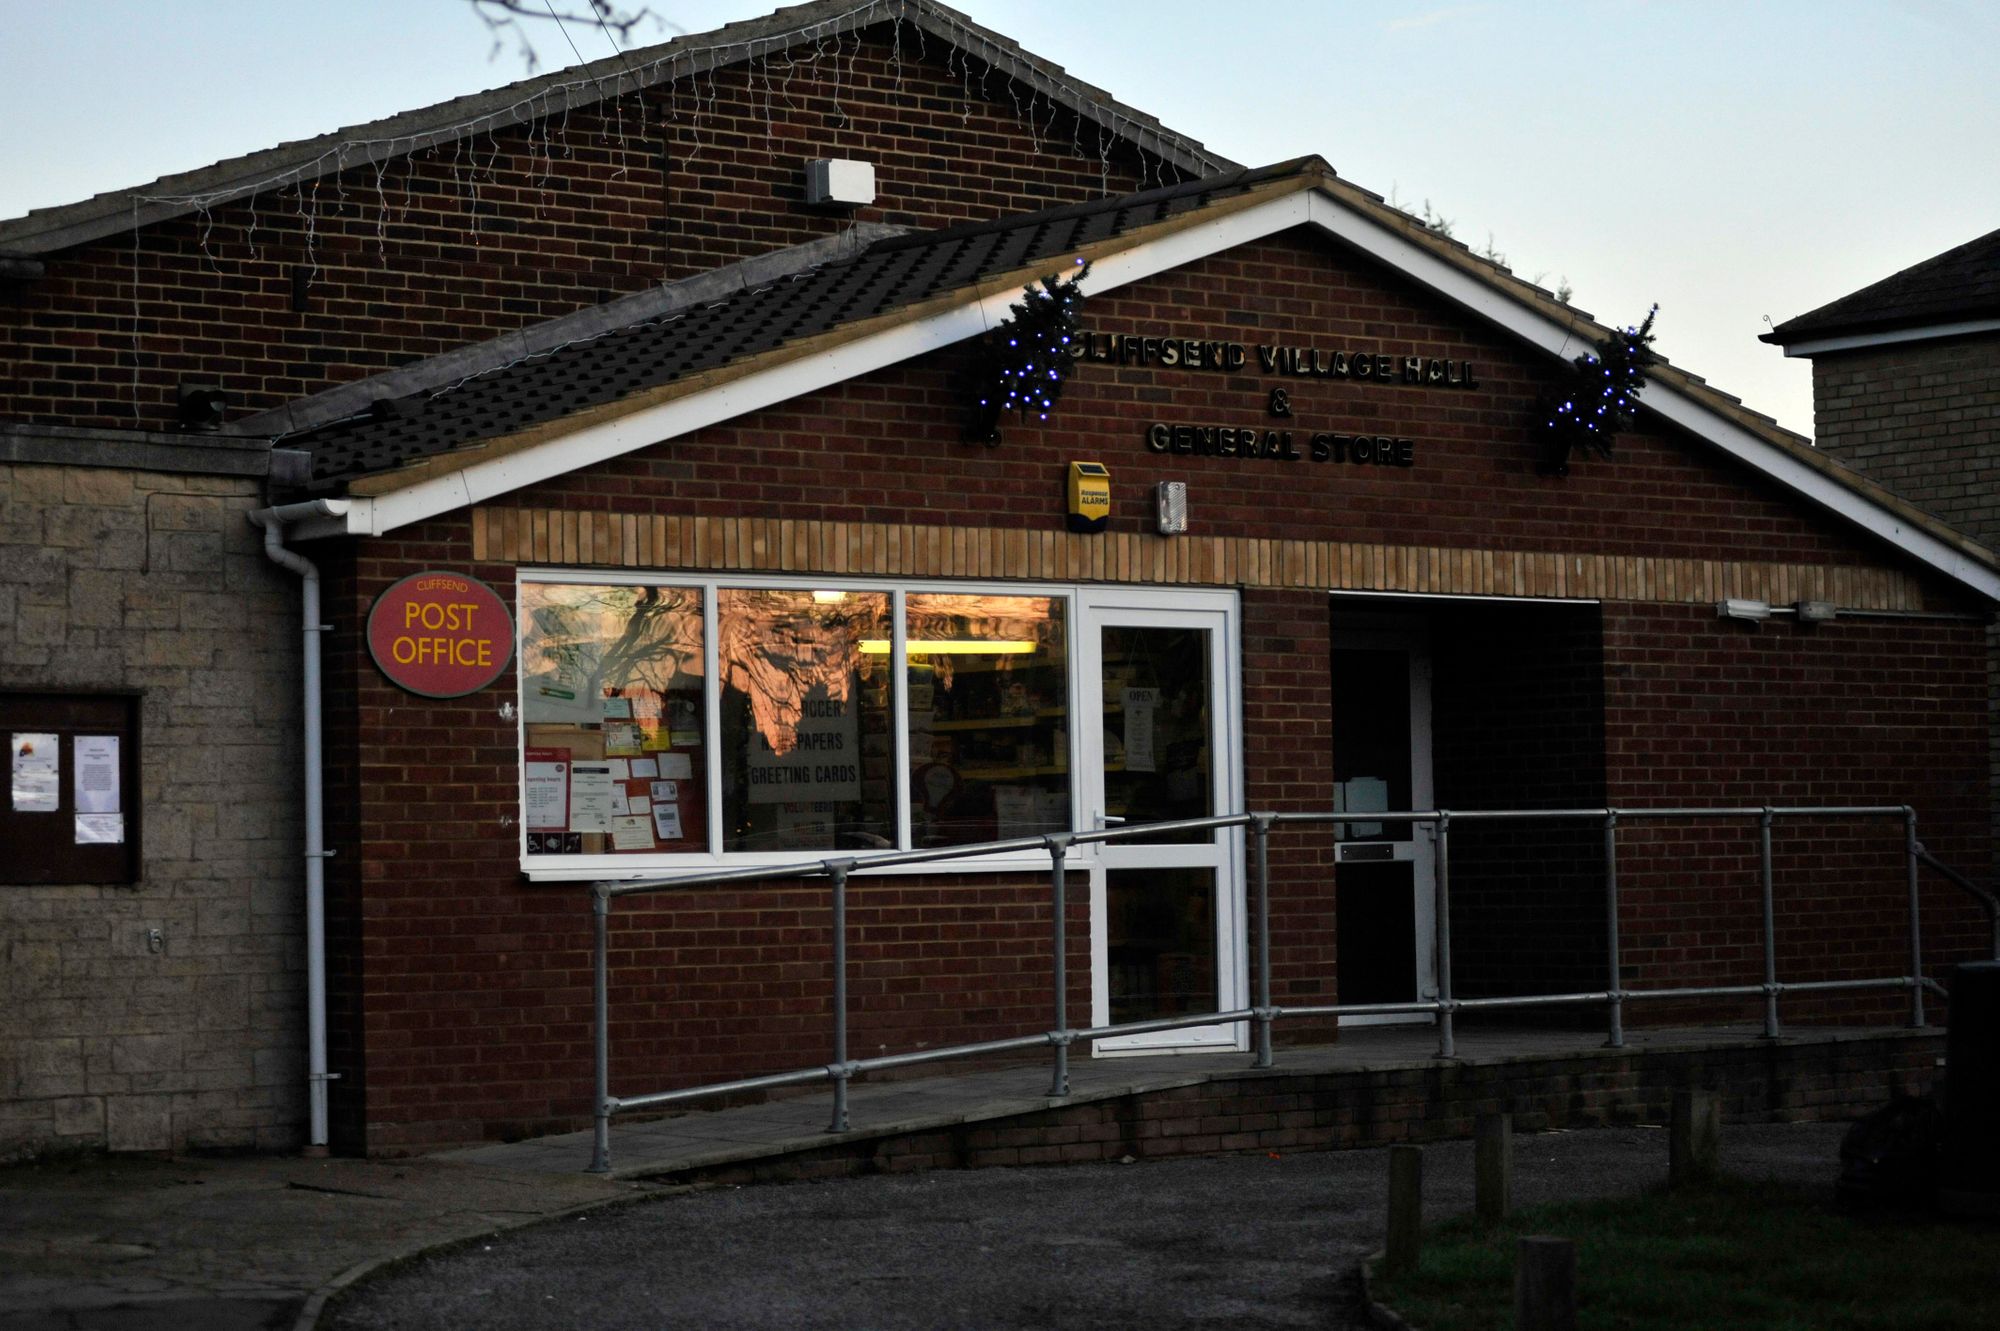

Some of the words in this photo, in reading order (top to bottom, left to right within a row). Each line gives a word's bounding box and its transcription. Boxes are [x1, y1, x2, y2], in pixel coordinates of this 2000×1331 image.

[1258, 343, 1393, 383] VILLAGE
[1403, 354, 1480, 389] HALL
[1269, 387, 1293, 417] &
[1148, 422, 1300, 460] GENERAL
[1311, 432, 1415, 466] STORE
[417, 578, 469, 593] CLIFFSEND
[405, 601, 479, 631] POST
[392, 636, 493, 667] OFFICE
[1129, 690, 1153, 702] OPEN
[761, 732, 844, 751] NPAPERS
[751, 766, 810, 785] GREETING
[815, 765, 857, 783] CARDS
